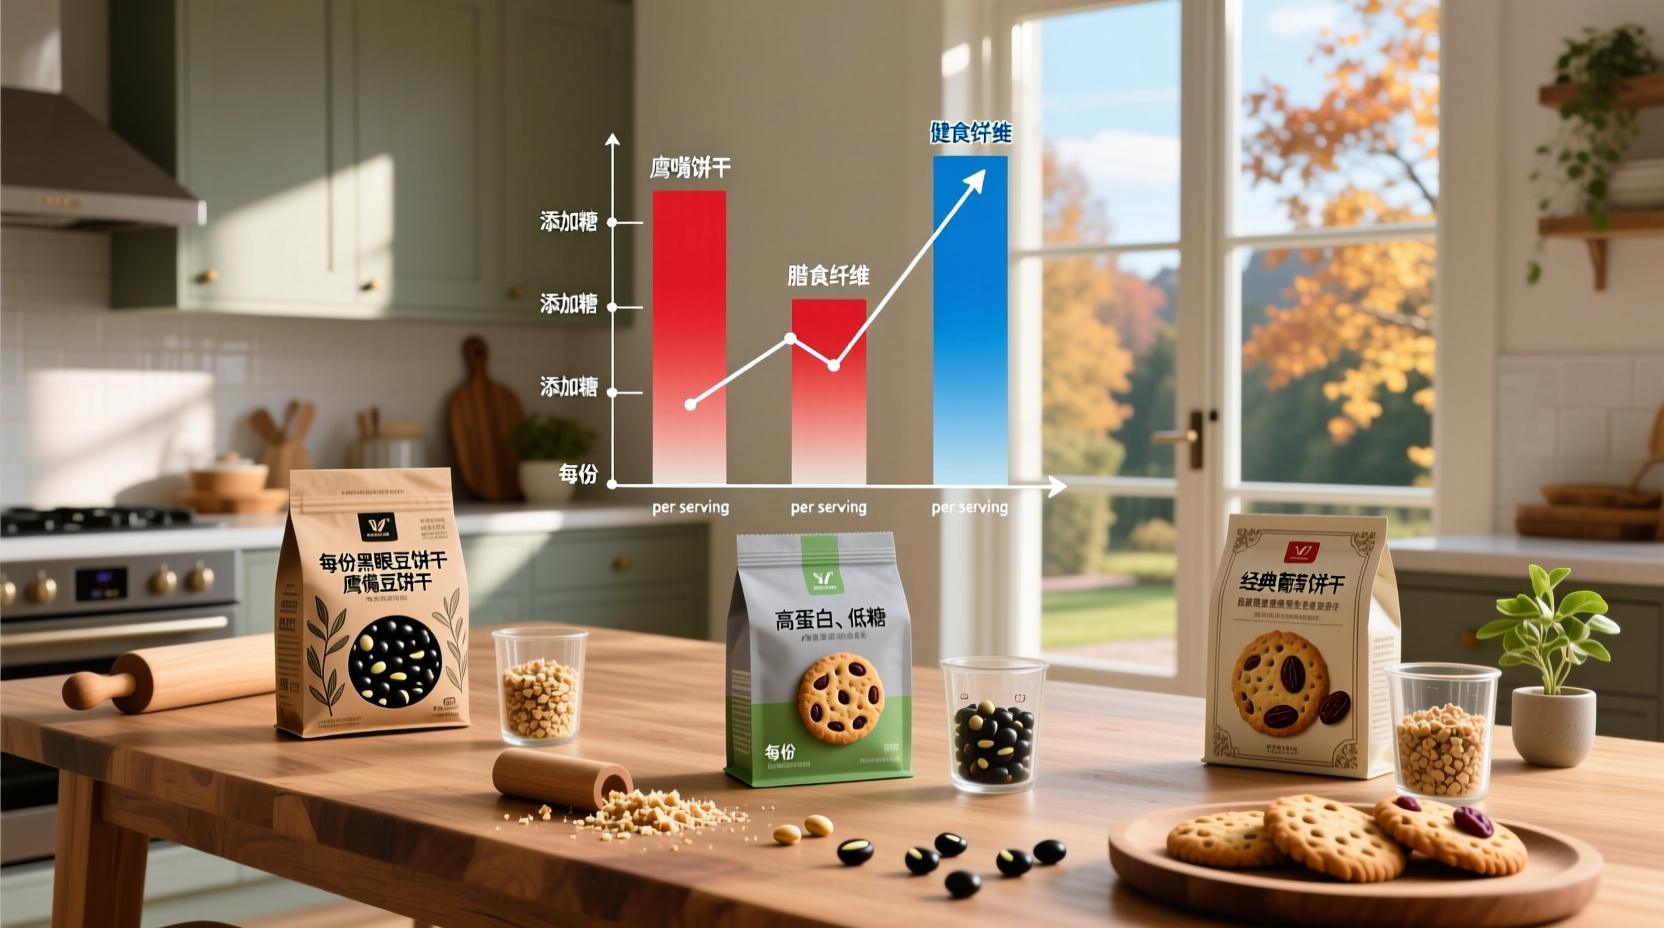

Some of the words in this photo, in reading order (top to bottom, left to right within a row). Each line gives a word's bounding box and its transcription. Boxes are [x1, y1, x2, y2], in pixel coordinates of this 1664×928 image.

[774, 606, 887, 632] 高蛋白、低糖
